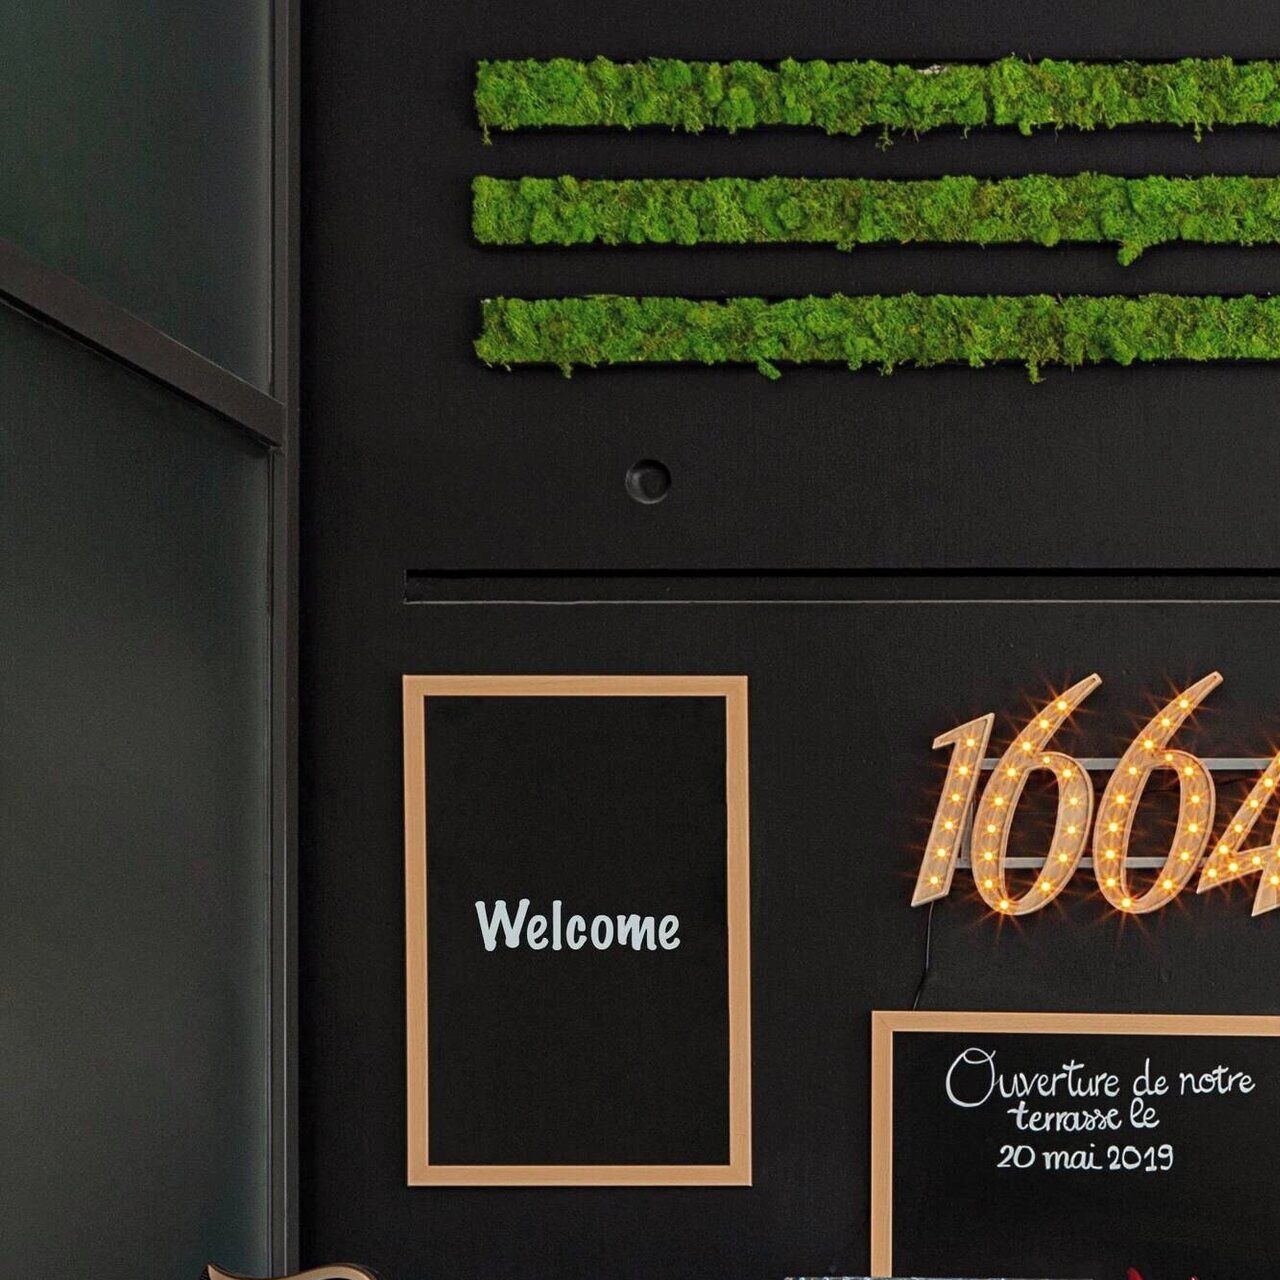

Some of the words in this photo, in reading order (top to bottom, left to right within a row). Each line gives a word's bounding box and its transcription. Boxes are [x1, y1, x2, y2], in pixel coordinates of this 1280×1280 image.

[475, 898, 681, 953] Welcome
[946, 1047, 1121, 1108] Ouverture
[1132, 1057, 1169, 1096] de
[1179, 1065, 1256, 1095] notre
[1007, 1100, 1122, 1132] terrasse
[1129, 1097, 1161, 1129] le
[996, 1144, 1036, 1168] 20
[1042, 1143, 1103, 1170] mai
[1106, 1144, 1175, 1172] 2019
